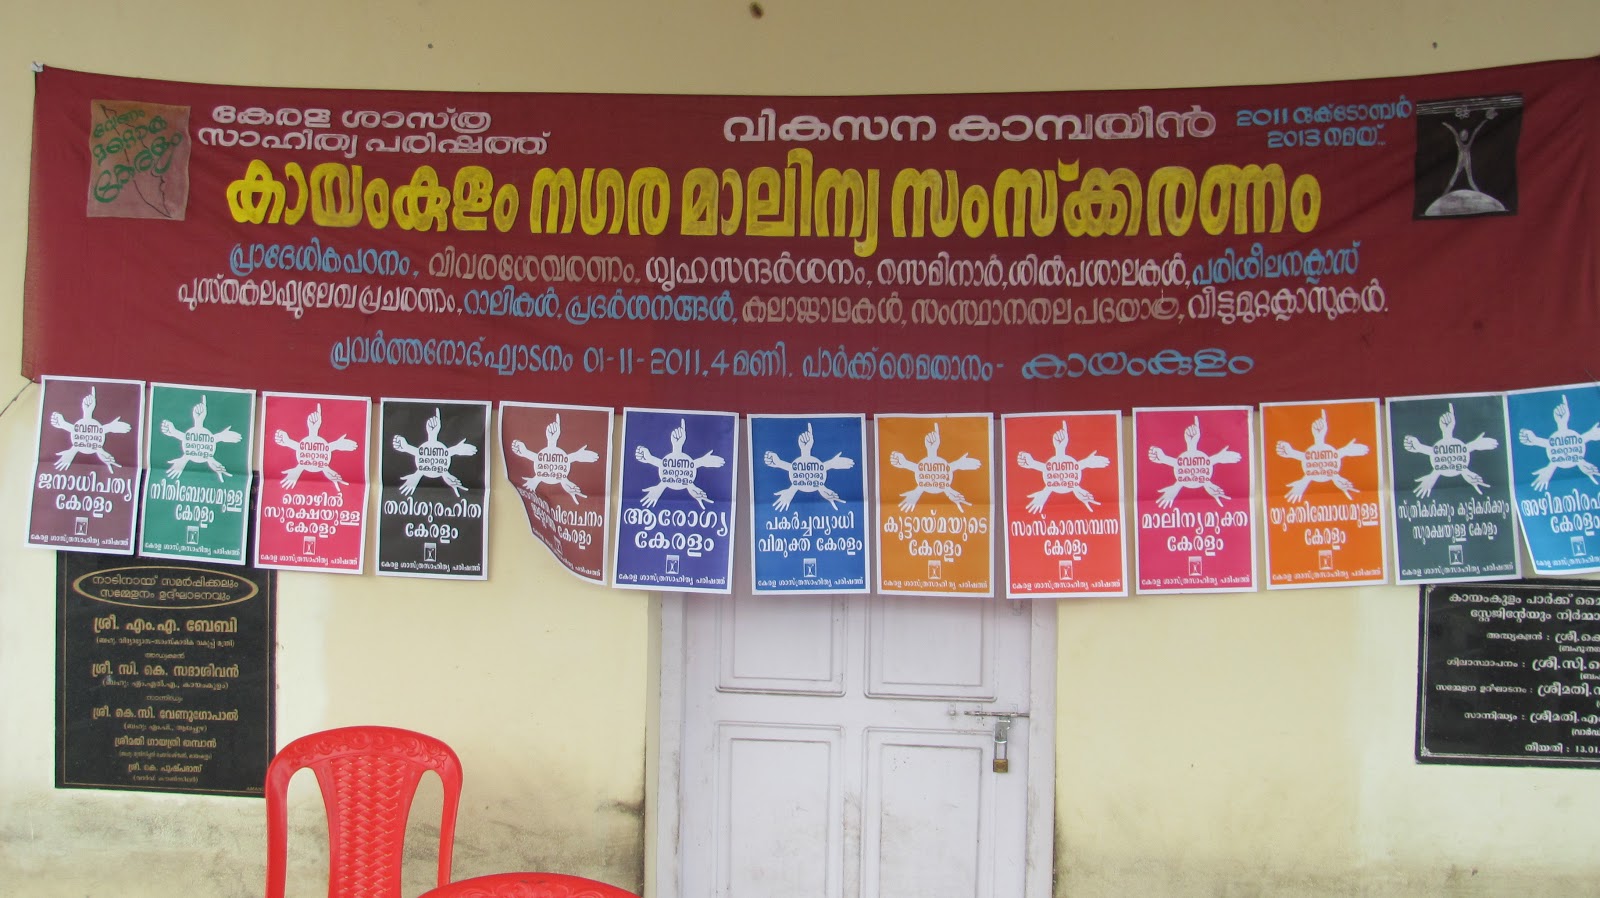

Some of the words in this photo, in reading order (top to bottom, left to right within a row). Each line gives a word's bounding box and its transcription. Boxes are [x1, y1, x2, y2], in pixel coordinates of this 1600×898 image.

[212, 105, 332, 126] കേരള
[342, 107, 492, 134] ശാസ്ത്ര
[724, 108, 936, 142] വികസന
[948, 105, 1216, 142] കാമ്പയിൻ
[1236, 108, 1288, 126] 2011
[198, 126, 356, 158] സാഹിത്യ
[365, 132, 551, 156] പരിഷത്ത്
[1267, 129, 1320, 148] 2013
[226, 159, 519, 232] കായംകുളം
[530, 167, 670, 236] നഗര
[680, 148, 880, 258] മാലിന്യ
[1022, 347, 1254, 380] കായംകുളം
[74, 424, 104, 434] വേണം
[186, 432, 214, 442] വേണം
[300, 442, 330, 451] വേണം
[1434, 444, 1468, 454] വേണം
[1549, 436, 1582, 446] വേണം
[419, 447, 448, 456] വേണം
[538, 453, 568, 463] വേണം
[1178, 457, 1210, 466] വേണം
[1304, 450, 1338, 460] വേണം
[662, 458, 694, 468] വേണം
[792, 462, 824, 470] വേണം
[918, 462, 950, 472] വേണം
[1046, 461, 1080, 471] വേണം
[38, 471, 132, 502] ജനാധിപത്യ
[56, 494, 112, 518] കേരളം
[282, 490, 344, 508] തൊഴിൽ
[384, 496, 482, 522] തരിശുരഹിത
[176, 504, 214, 528] കേരളം
[264, 504, 360, 526] സുരക്ഷയുള്ള
[550, 504, 603, 528] വിവേചനം
[624, 508, 728, 537] ആരോഗ്യ
[766, 510, 854, 536] പകർച്ചവ്യാധി
[1142, 508, 1248, 534] മാലിന്യമുക്ത
[1551, 513, 1600, 536] കേരളം
[286, 521, 336, 538] കേരളം
[405, 522, 458, 544] കേരളം
[557, 526, 592, 550] കേരളം
[1304, 528, 1346, 550] കേരളം
[1468, 522, 1498, 540] കേരളം
[634, 532, 715, 558] കേരളം
[758, 536, 810, 558] വിമുക്ത
[816, 536, 863, 556] കേരളം
[909, 540, 962, 562] കേരളം
[1044, 540, 1088, 560] കേരളം
[1167, 536, 1224, 556] കേരളം
[1448, 593, 1522, 606] കായംകുളം
[186, 616, 238, 634] ബേബി
